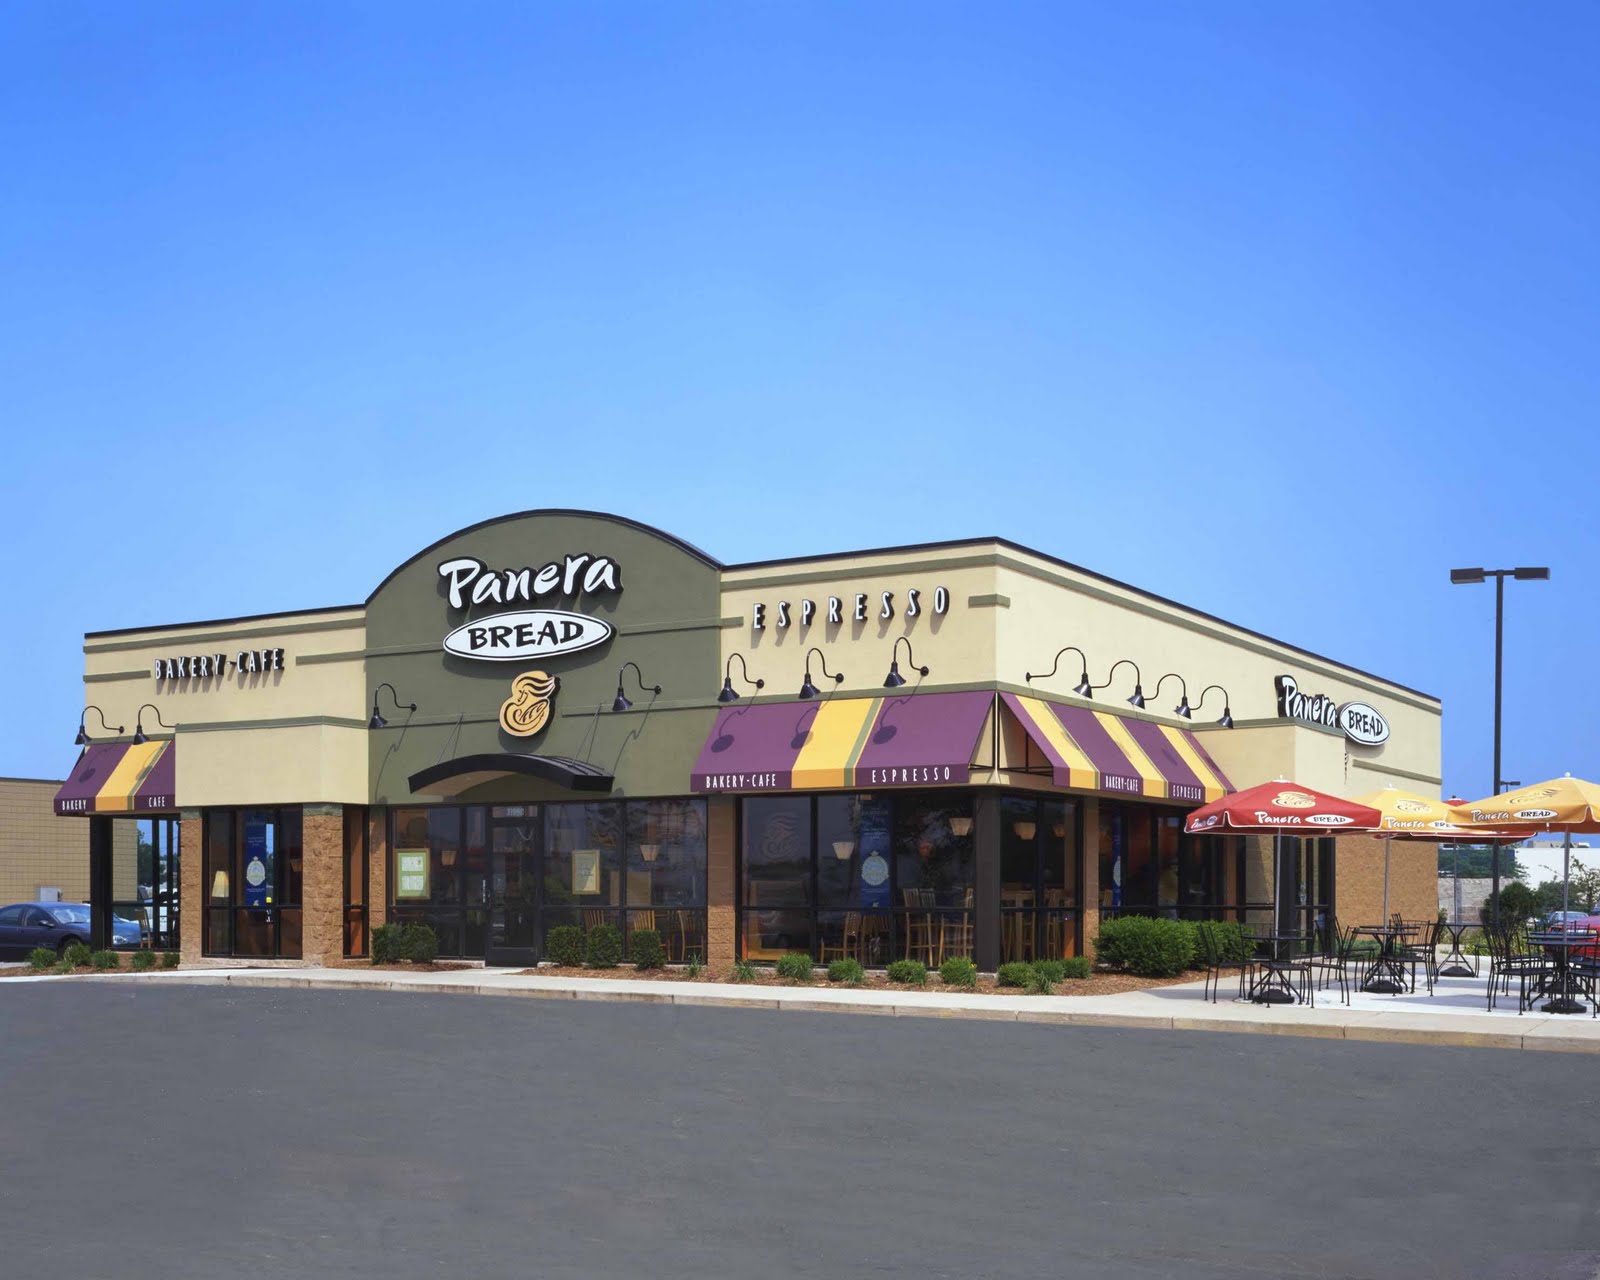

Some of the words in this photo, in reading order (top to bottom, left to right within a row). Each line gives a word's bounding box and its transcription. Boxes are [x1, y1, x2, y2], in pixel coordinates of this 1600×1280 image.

[438, 554, 619, 609] Panera
[752, 586, 948, 630] ESPRESSO
[467, 620, 584, 650] BREAD
[1280, 675, 1337, 728] Panera
[1348, 710, 1383, 737] BREAD
[872, 766, 950, 783] ESPRESSO
[1172, 785, 1201, 800] ESPRESSO
[62, 800, 87, 811] BAKERY
[148, 796, 165, 807] CAFE
[1254, 811, 1301, 824] Panera
[1384, 816, 1425, 829] Panera
[1470, 809, 1509, 822] Panera
